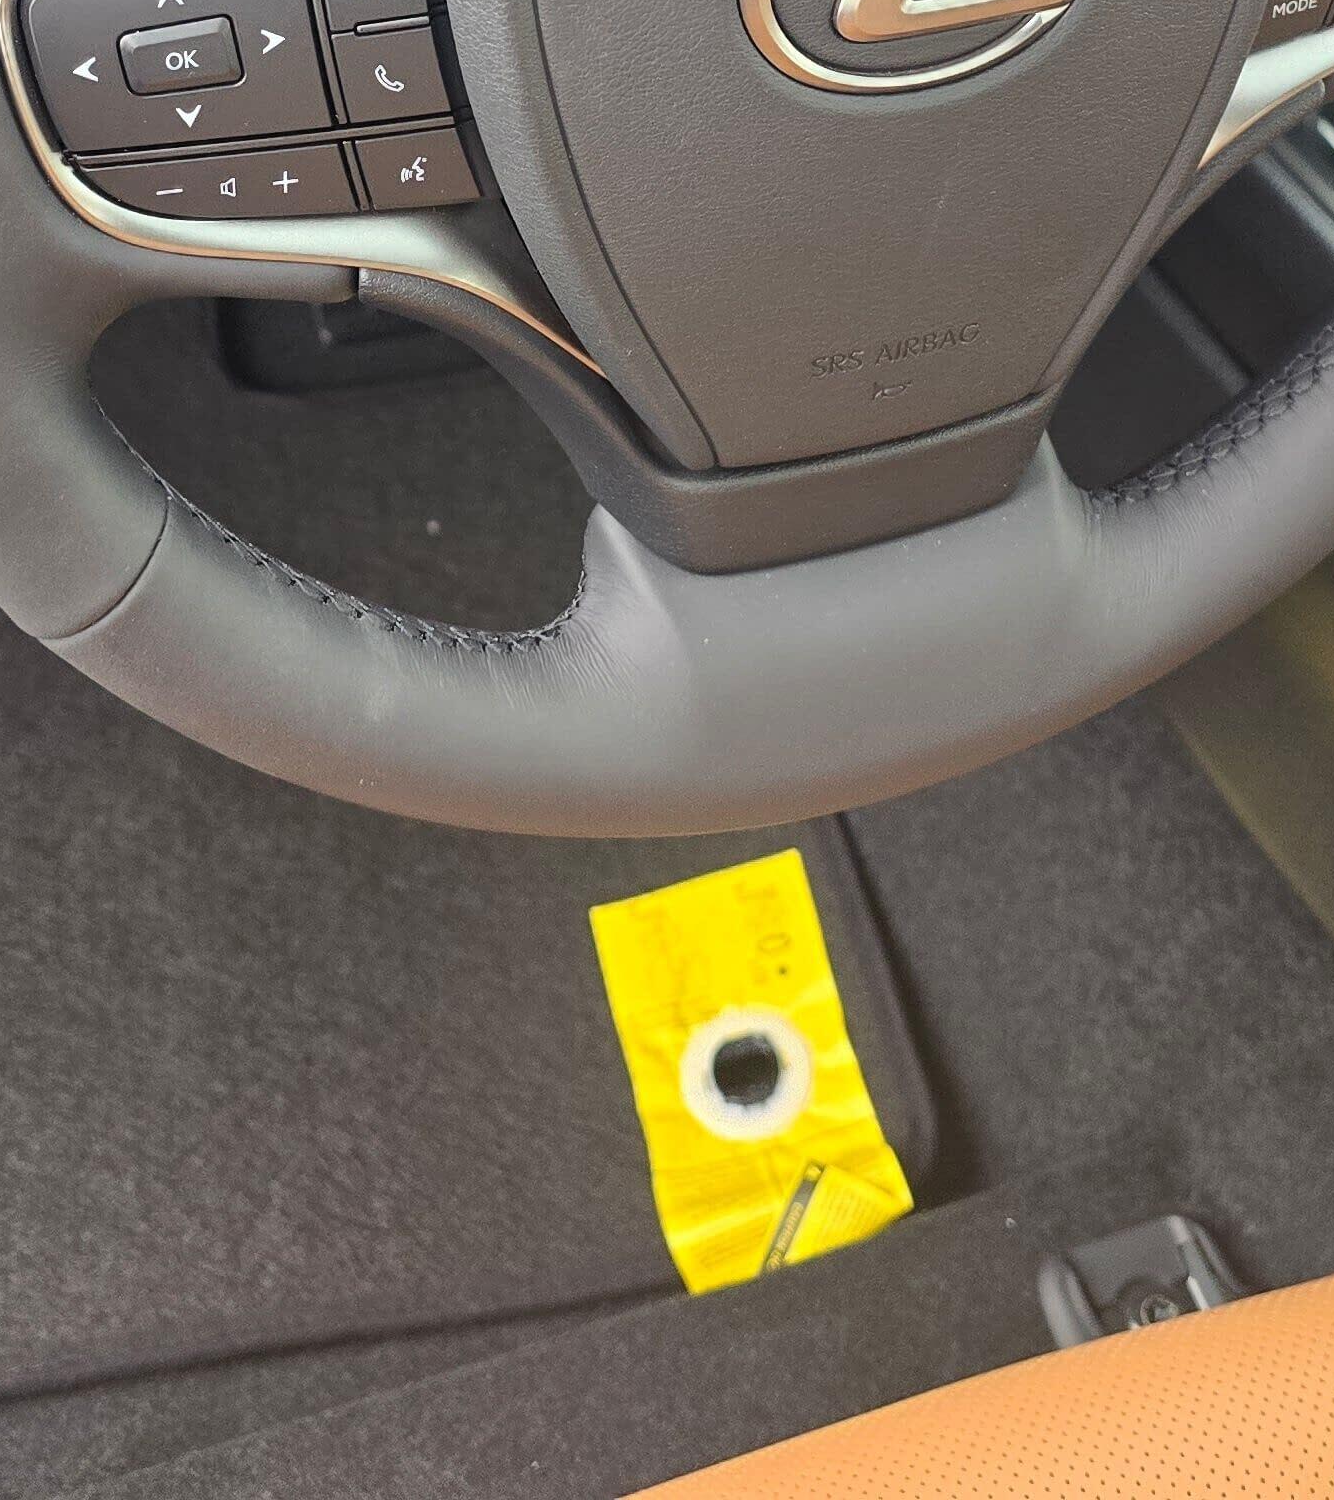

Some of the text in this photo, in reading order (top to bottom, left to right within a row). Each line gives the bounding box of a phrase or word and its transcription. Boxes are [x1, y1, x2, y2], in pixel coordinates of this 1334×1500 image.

[165, 49, 200, 71] OK
[810, 322, 981, 380] SRS AIRBAG
